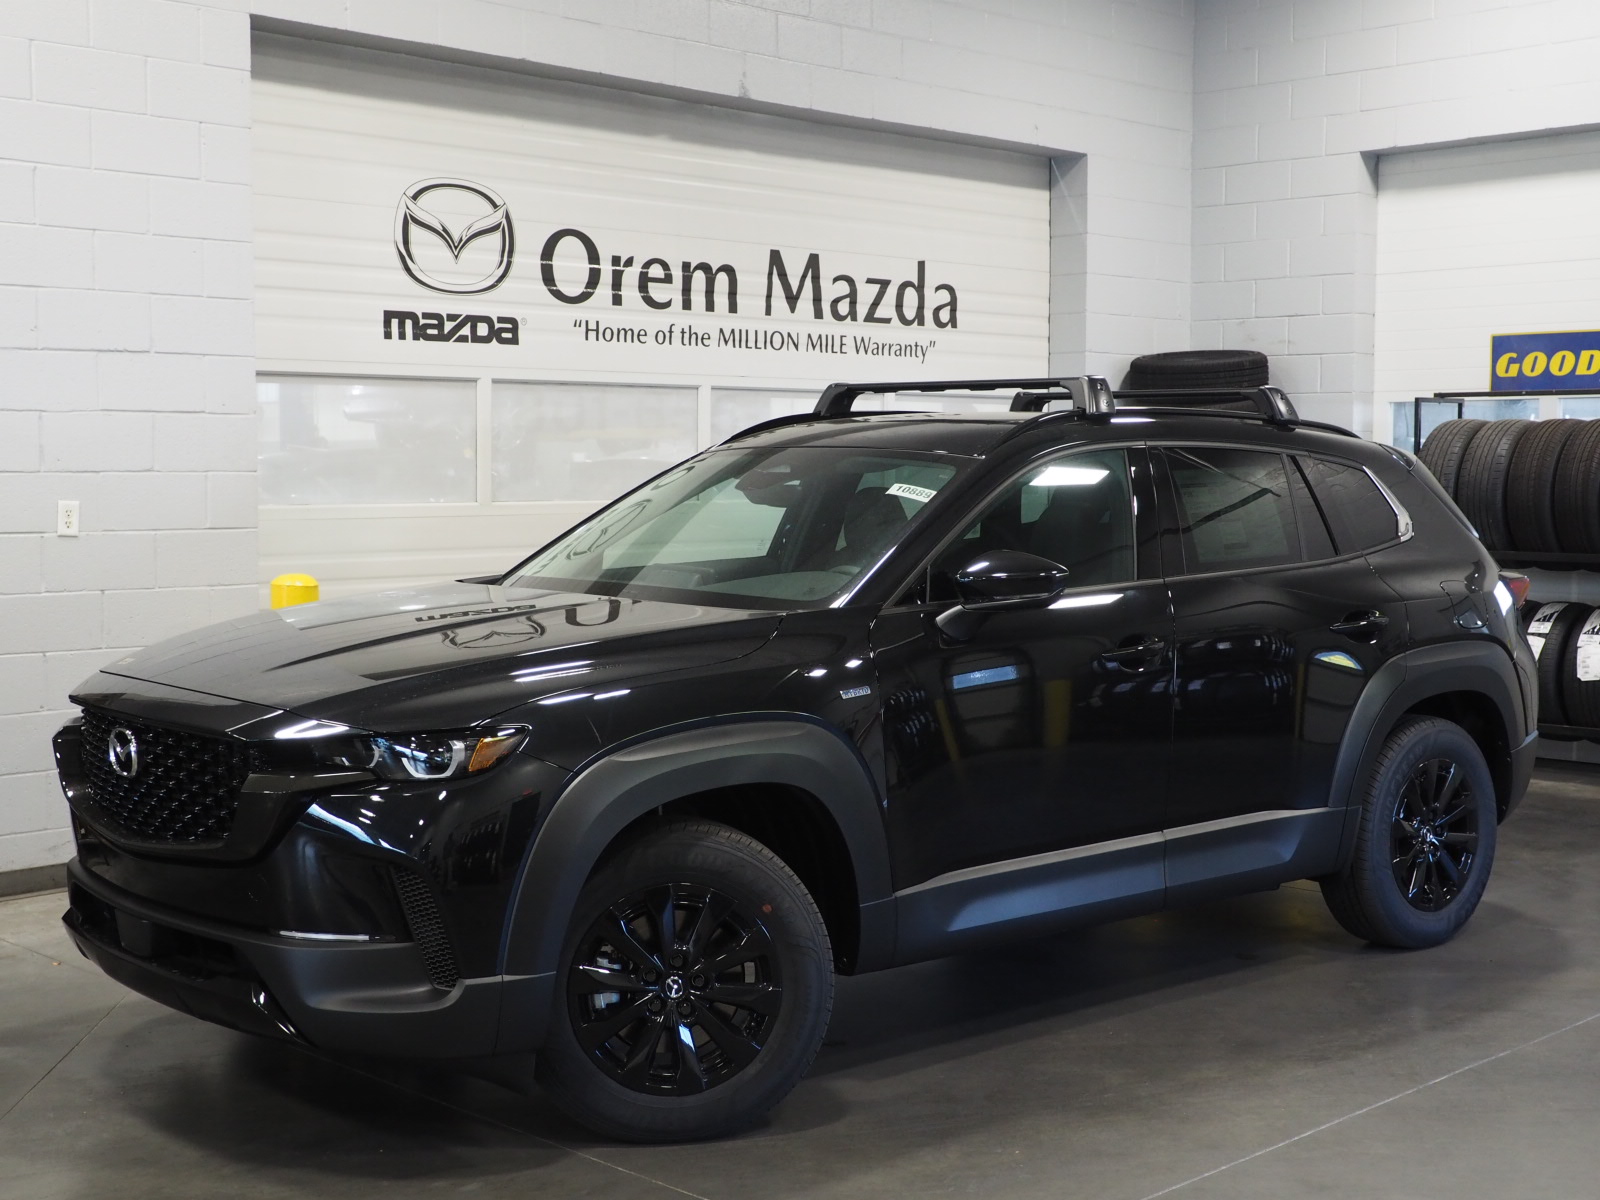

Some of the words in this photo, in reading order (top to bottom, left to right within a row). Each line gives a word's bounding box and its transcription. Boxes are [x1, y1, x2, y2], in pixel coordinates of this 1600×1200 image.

[540, 228, 738, 315] Orem
[764, 248, 958, 329] Mazda
[654, 323, 676, 346] of
[679, 324, 711, 348] the
[717, 327, 799, 352] MILLION
[806, 333, 848, 355] MILE
[1495, 350, 1600, 377] GOOD
[895, 485, 933, 499] 10889
